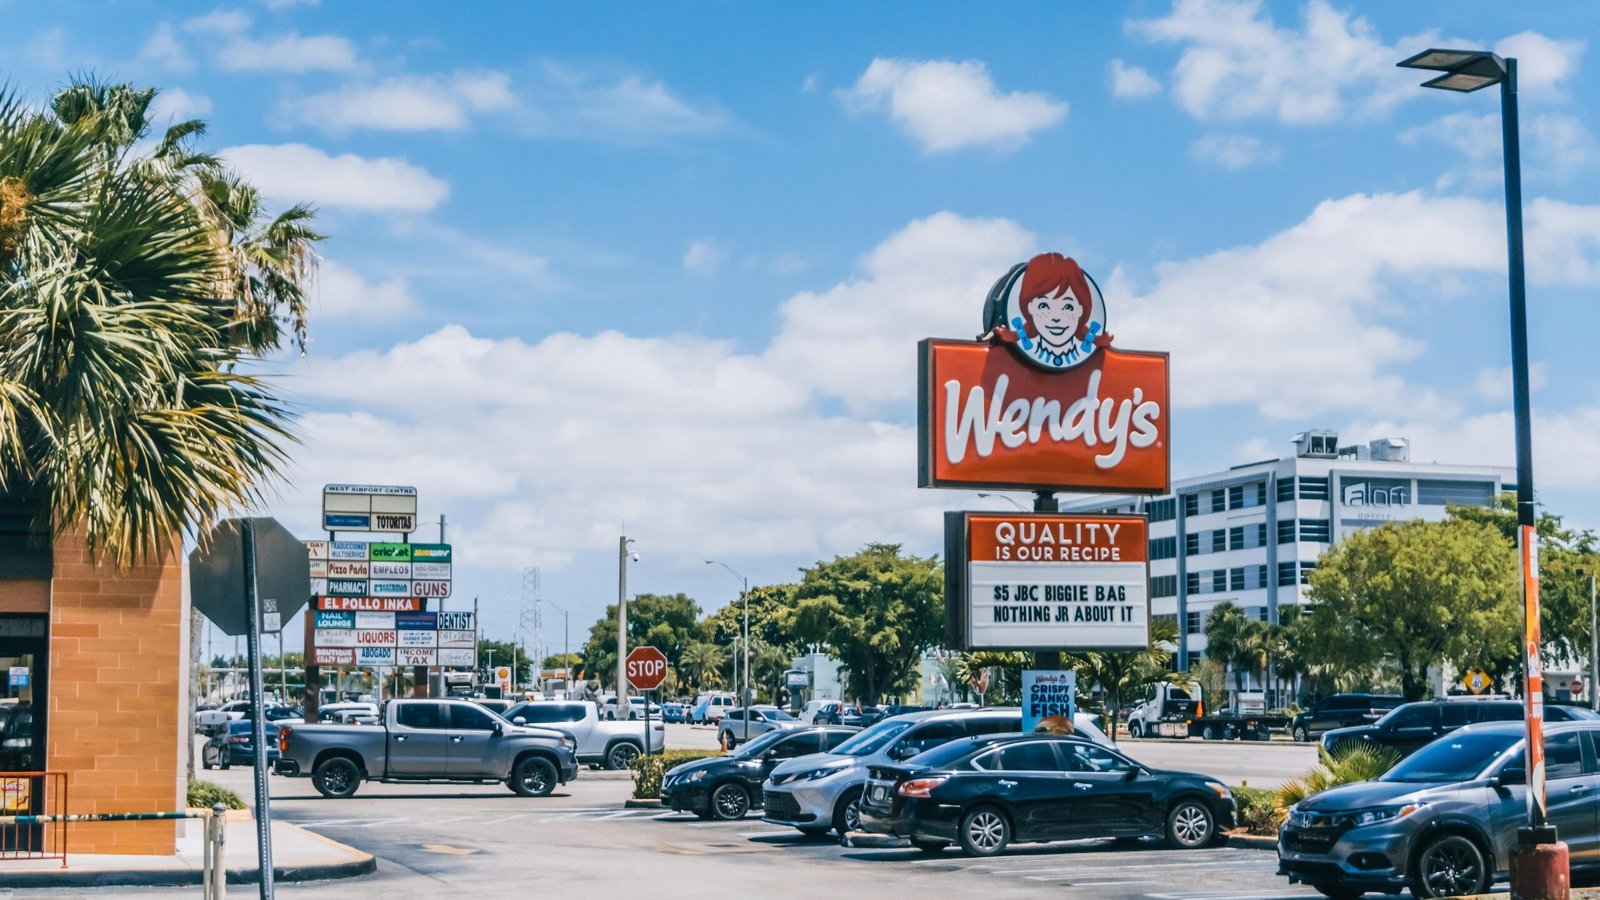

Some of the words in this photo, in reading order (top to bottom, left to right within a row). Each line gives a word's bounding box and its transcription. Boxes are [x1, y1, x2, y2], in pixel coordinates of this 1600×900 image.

[945, 369, 1160, 469] Wendy's
[1344, 482, 1407, 507] aloft
[376, 516, 412, 529] TOTORITAS
[995, 522, 1120, 546] QUALITY
[373, 547, 409, 556] cricket
[996, 546, 1010, 560] IS
[1016, 546, 1054, 560] OUR
[1060, 547, 1120, 561] RECIPE
[329, 563, 348, 574] Pizza
[349, 564, 368, 574] Pasta
[374, 566, 409, 574] EMPLEOS
[330, 581, 366, 594] PHARMACY
[414, 582, 448, 596] GUNS
[1014, 585, 1038, 601] JBC
[1045, 586, 1088, 601] BIGGIE
[1095, 586, 1126, 601] BAG
[324, 598, 339, 610] EL
[342, 598, 380, 610] POLLO
[384, 598, 413, 610] INKA
[994, 605, 1050, 623] NOTHING
[1055, 605, 1069, 622] JR
[1074, 606, 1116, 622] ABOUT
[1121, 606, 1134, 622] IT
[439, 613, 472, 629] DENTIST
[357, 632, 395, 644] LIQUORS
[362, 648, 391, 658] ABOGADO
[405, 656, 428, 664] TAX
[628, 660, 664, 677] STOP
[1030, 684, 1070, 694] CRISPY
[1030, 694, 1070, 704] PANKO
[1030, 704, 1070, 718] FISH
